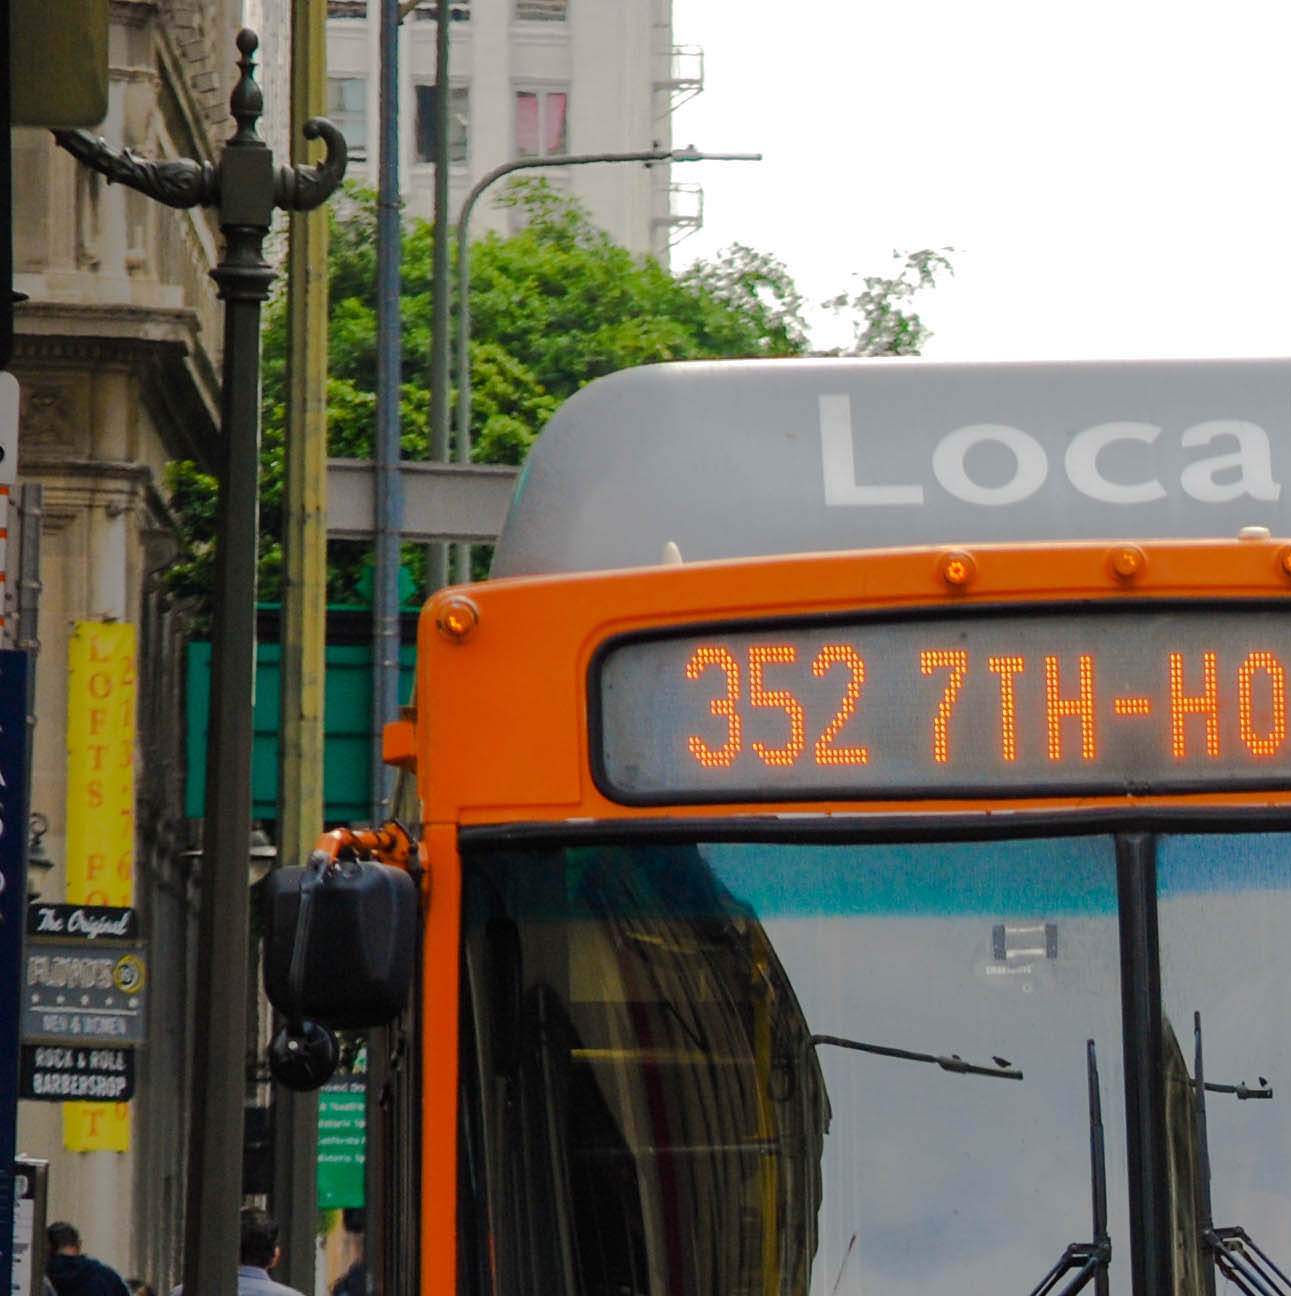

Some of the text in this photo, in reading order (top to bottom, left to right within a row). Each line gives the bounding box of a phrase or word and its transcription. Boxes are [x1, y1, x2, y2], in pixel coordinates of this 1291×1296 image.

[684, 644, 870, 768] 352
[36, 907, 132, 939] The Original
[35, 1048, 72, 1069] ROCK
[90, 1050, 127, 1071] ROLL
[32, 1073, 128, 1097] BARBERSHOP
